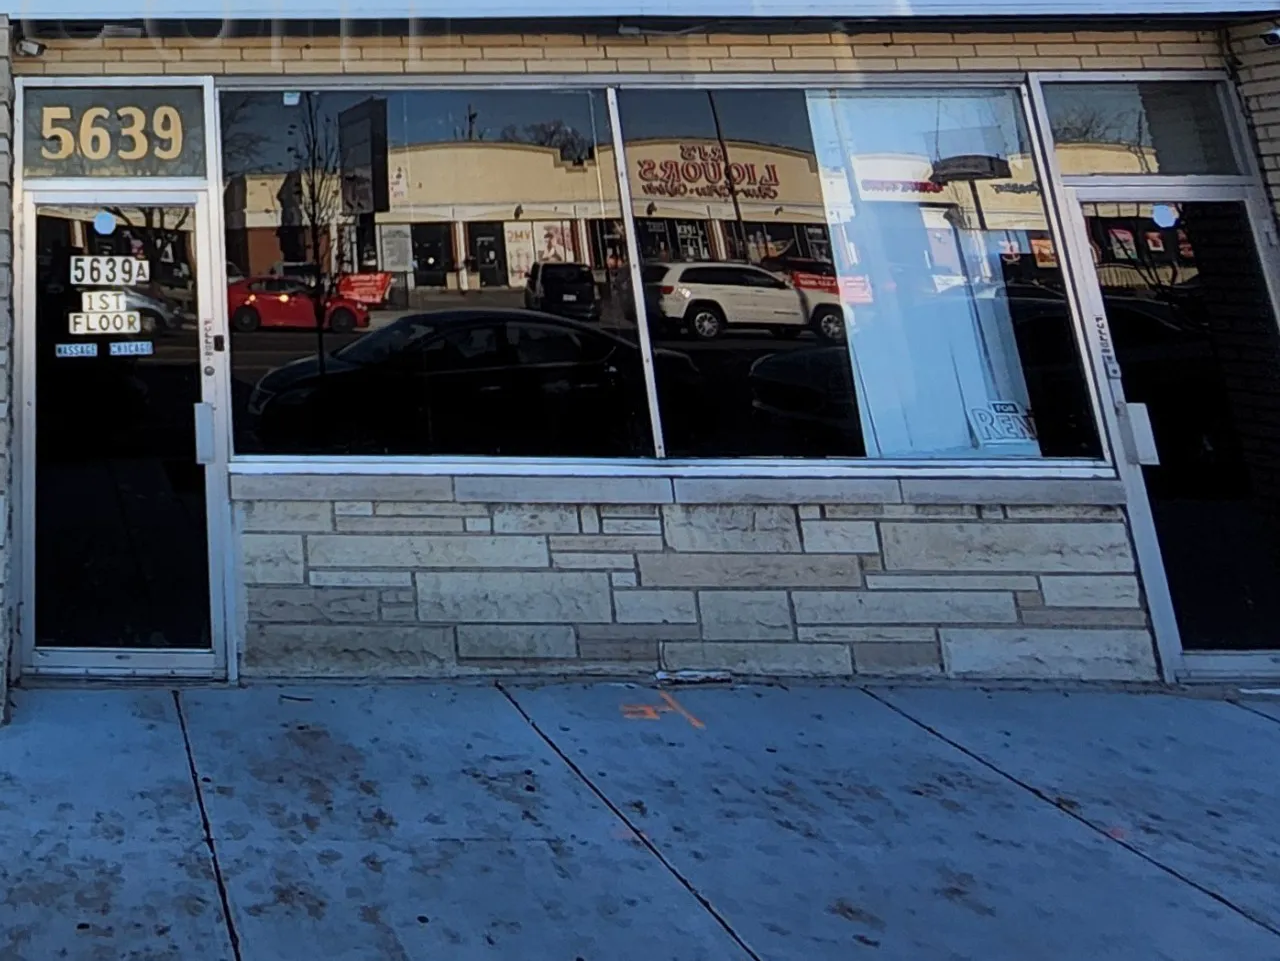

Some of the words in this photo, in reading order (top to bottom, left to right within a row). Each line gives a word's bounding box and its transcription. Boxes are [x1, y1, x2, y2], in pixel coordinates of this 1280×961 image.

[41, 105, 184, 160] 5639
[87, 293, 124, 311] 1ST
[72, 314, 137, 333] FLOOR
